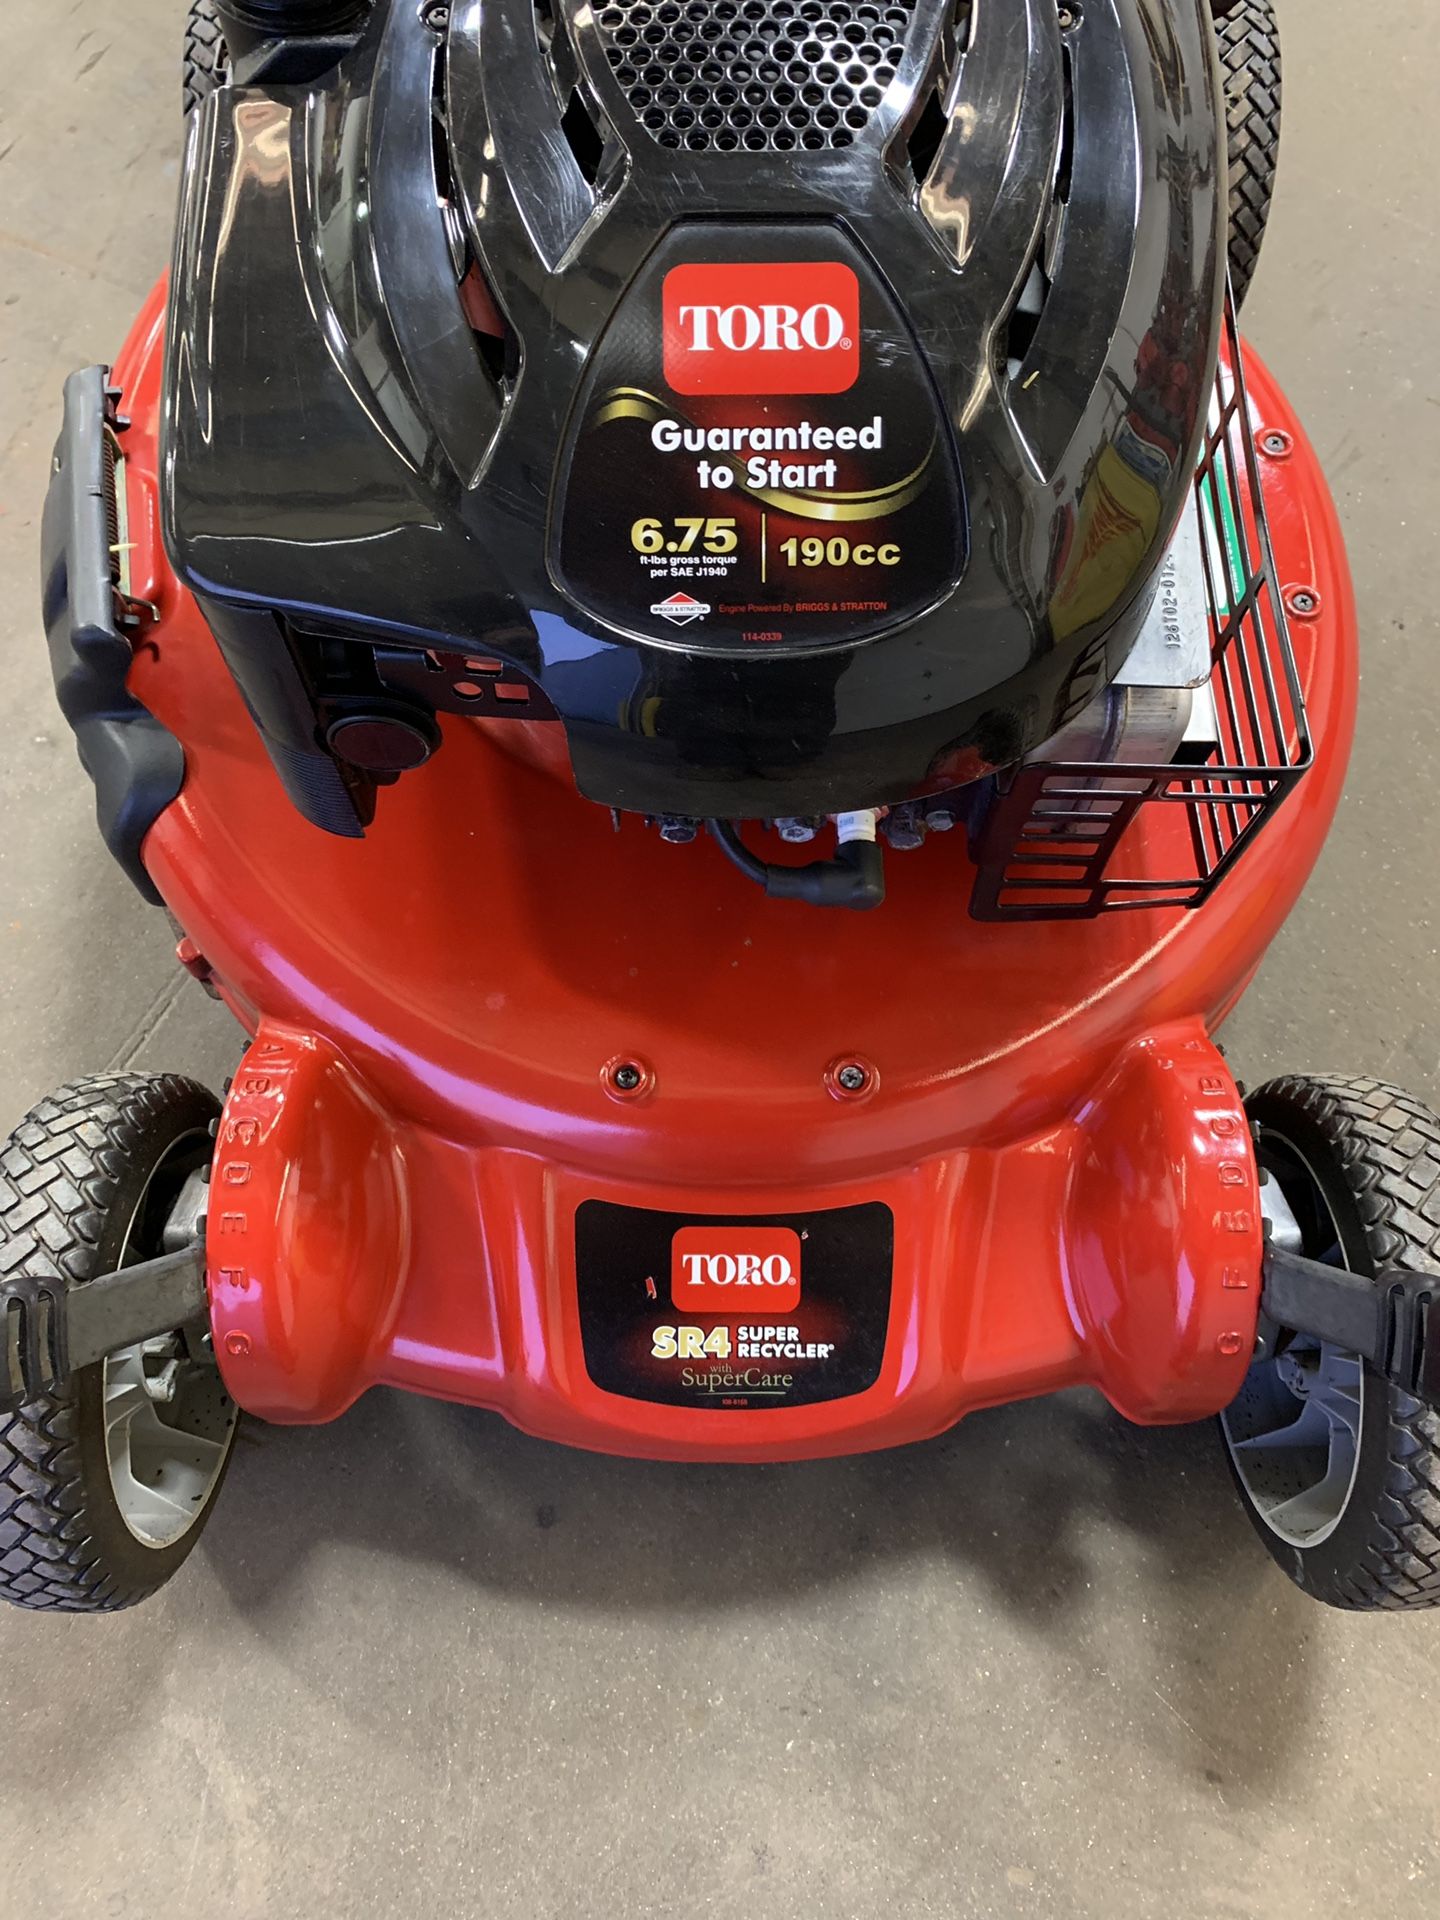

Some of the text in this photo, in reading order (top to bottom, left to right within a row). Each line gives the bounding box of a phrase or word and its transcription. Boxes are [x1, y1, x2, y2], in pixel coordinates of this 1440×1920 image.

[650, 416, 883, 452] Guaranteed
[696, 457, 838, 489] to Start
[630, 517, 739, 554] 6.75
[639, 555, 738, 566] ft-lbs gross torque
[779, 537, 901, 567] 190cc
[650, 566, 728, 578] per SAE J1940
[718, 601, 887, 614] Engine Powered By BRIGGS & STRATTON
[741, 632, 782, 641] 114-0339
[245, 1077, 270, 1095] B
[1200, 1076, 1227, 1096] B
[222, 1161, 252, 1185] D
[1218, 1161, 1246, 1186] D
[219, 1211, 248, 1234] E
[220, 1266, 250, 1291] F
[1222, 1266, 1248, 1288] F
[651, 1325, 732, 1359] SR4
[737, 1326, 799, 1341] SUPER
[681, 1367, 794, 1391] SuperCare
[709, 1364, 733, 1374] with
